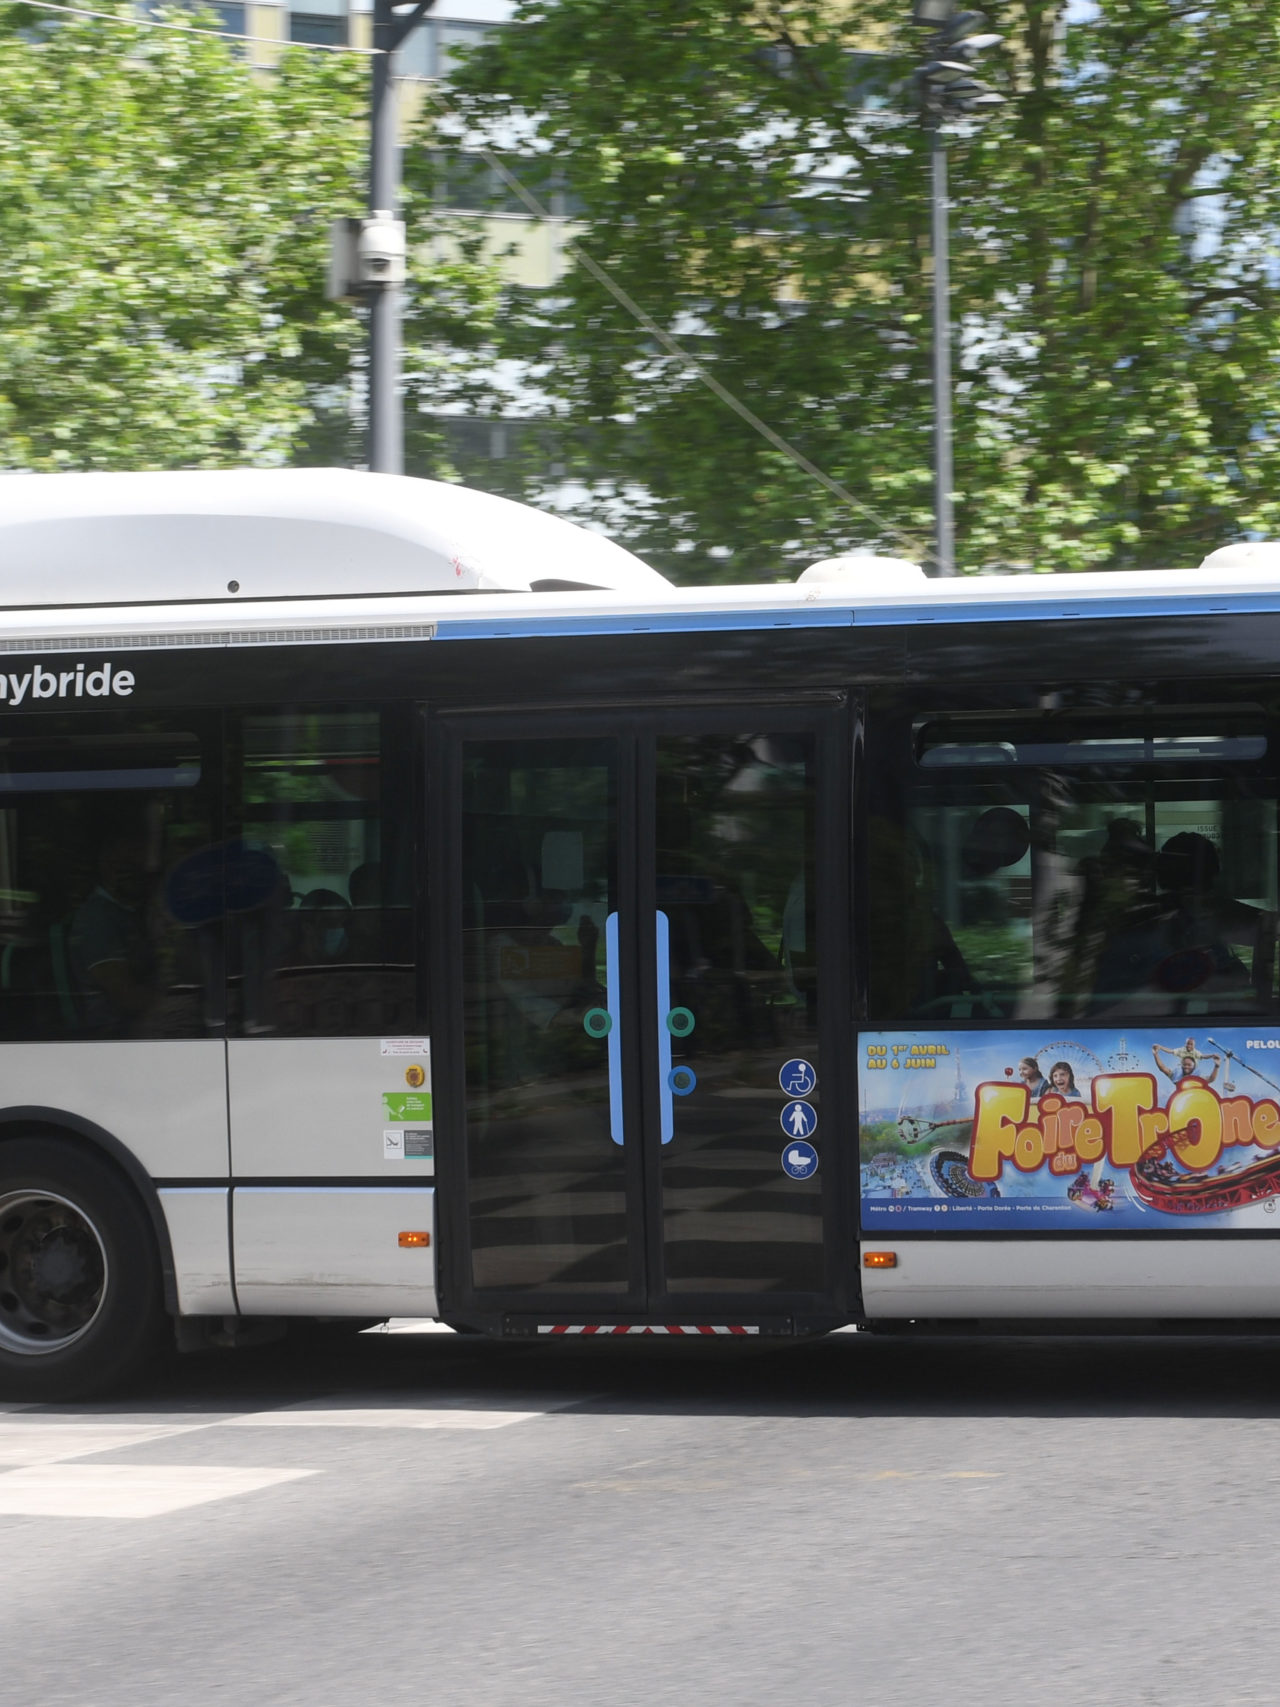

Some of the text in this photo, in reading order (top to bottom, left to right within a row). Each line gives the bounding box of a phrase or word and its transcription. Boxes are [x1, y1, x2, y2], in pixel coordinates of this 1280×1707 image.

[867, 1045, 887, 1056] DU
[911, 1045, 950, 1056] AVRIL
[867, 1058, 936, 1069] AU 6 JUIN
[968, 1081, 1104, 1182] Foire
[1053, 1151, 1078, 1171] du
